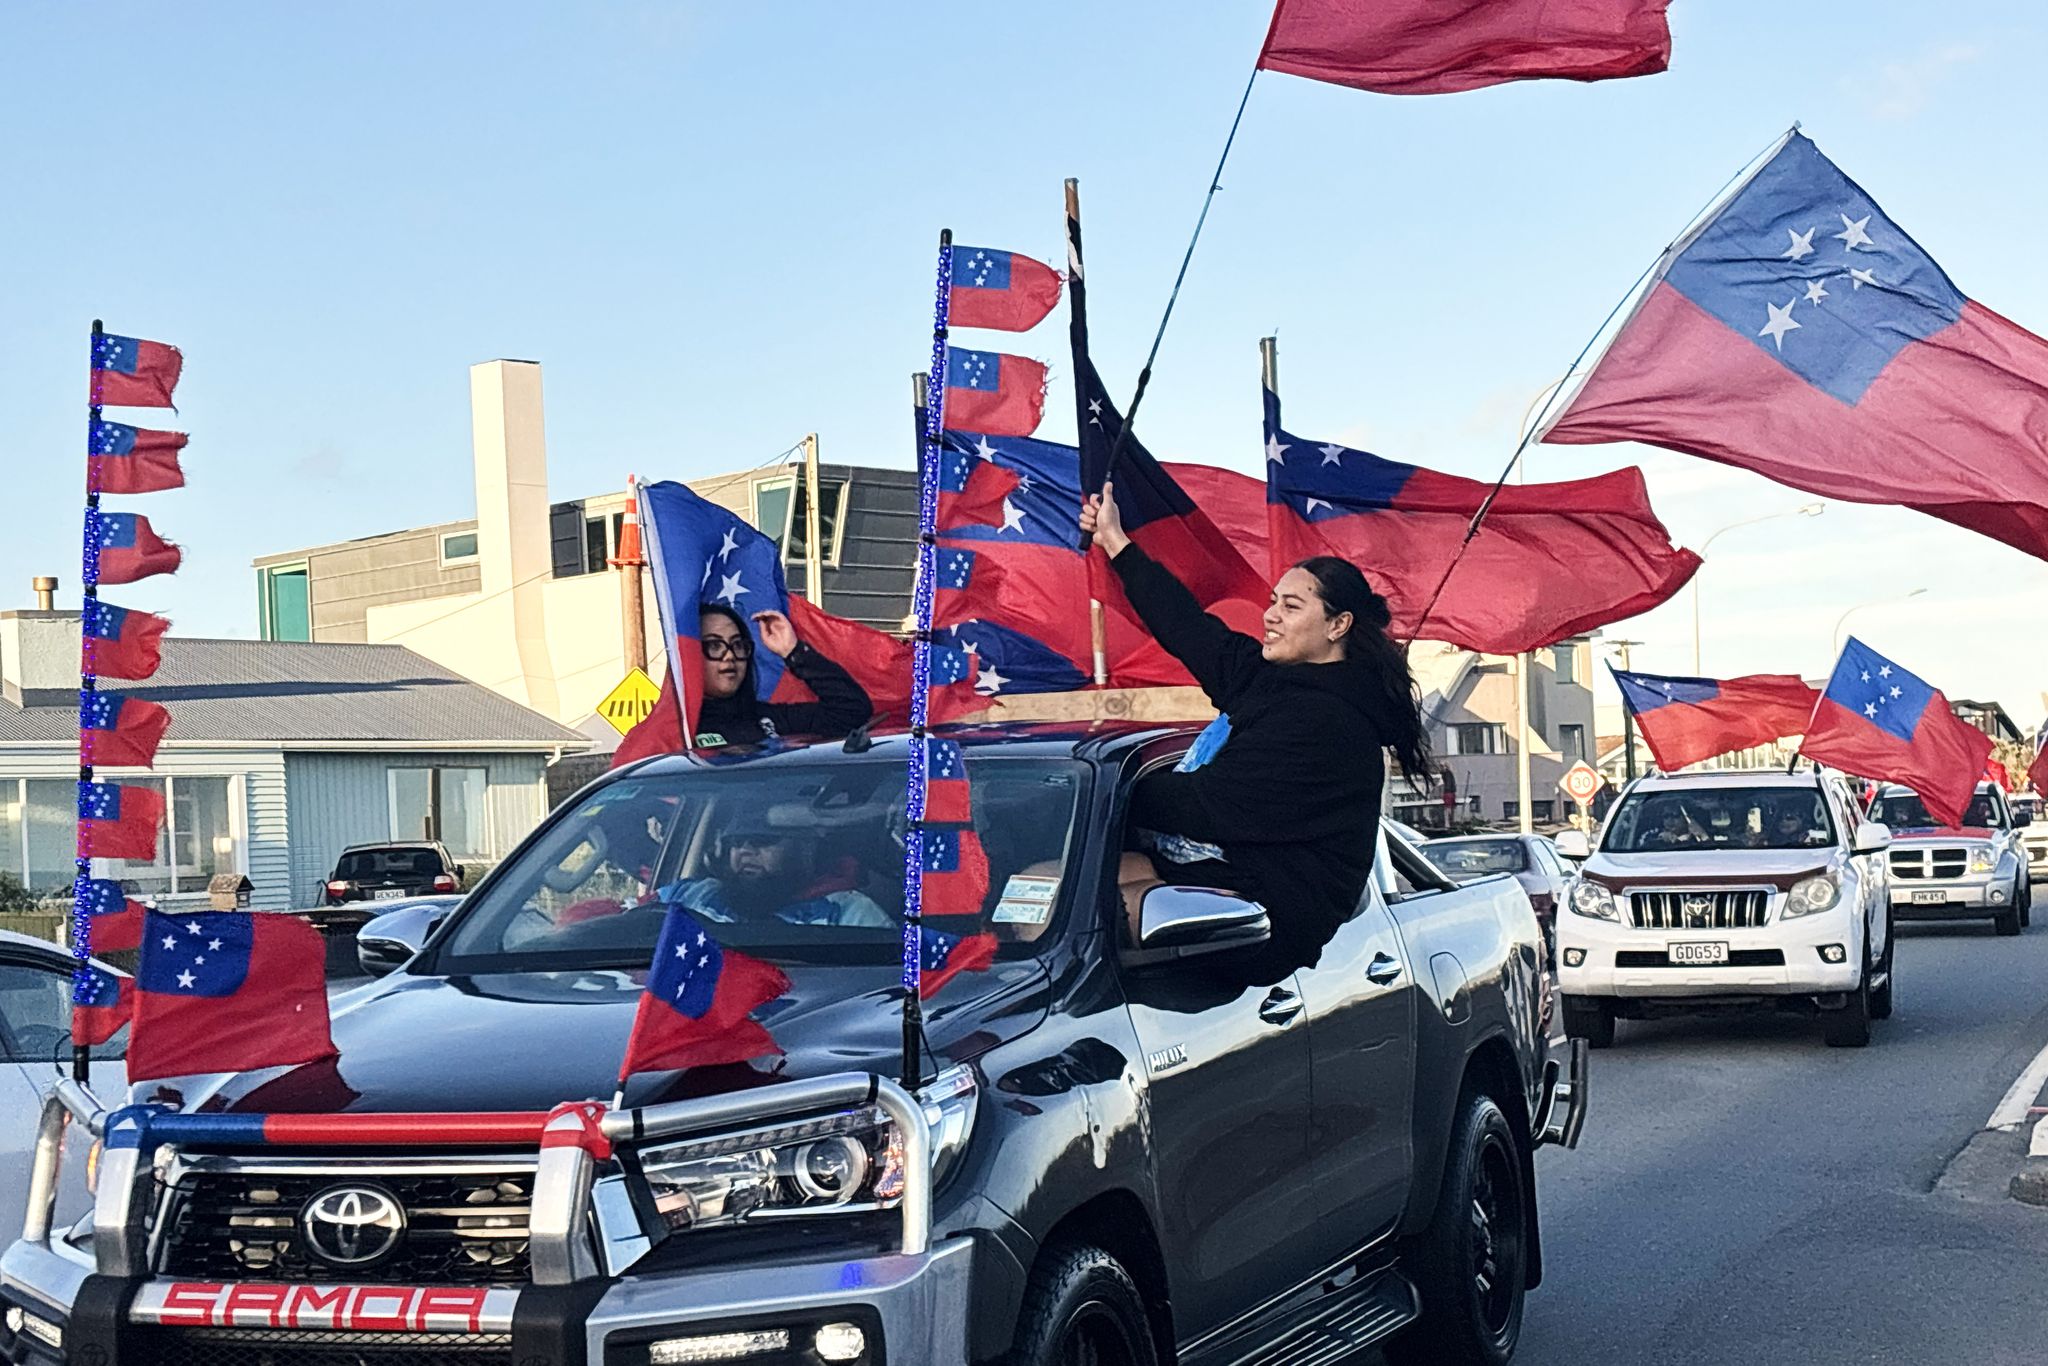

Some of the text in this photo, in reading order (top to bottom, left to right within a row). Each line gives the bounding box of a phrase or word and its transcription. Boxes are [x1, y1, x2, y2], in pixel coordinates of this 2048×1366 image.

[1574, 777, 1590, 788] 30
[1676, 945, 1721, 959] GDG53
[1149, 1043, 1187, 1073] HILUX
[160, 1282, 488, 1333] SAMOA
